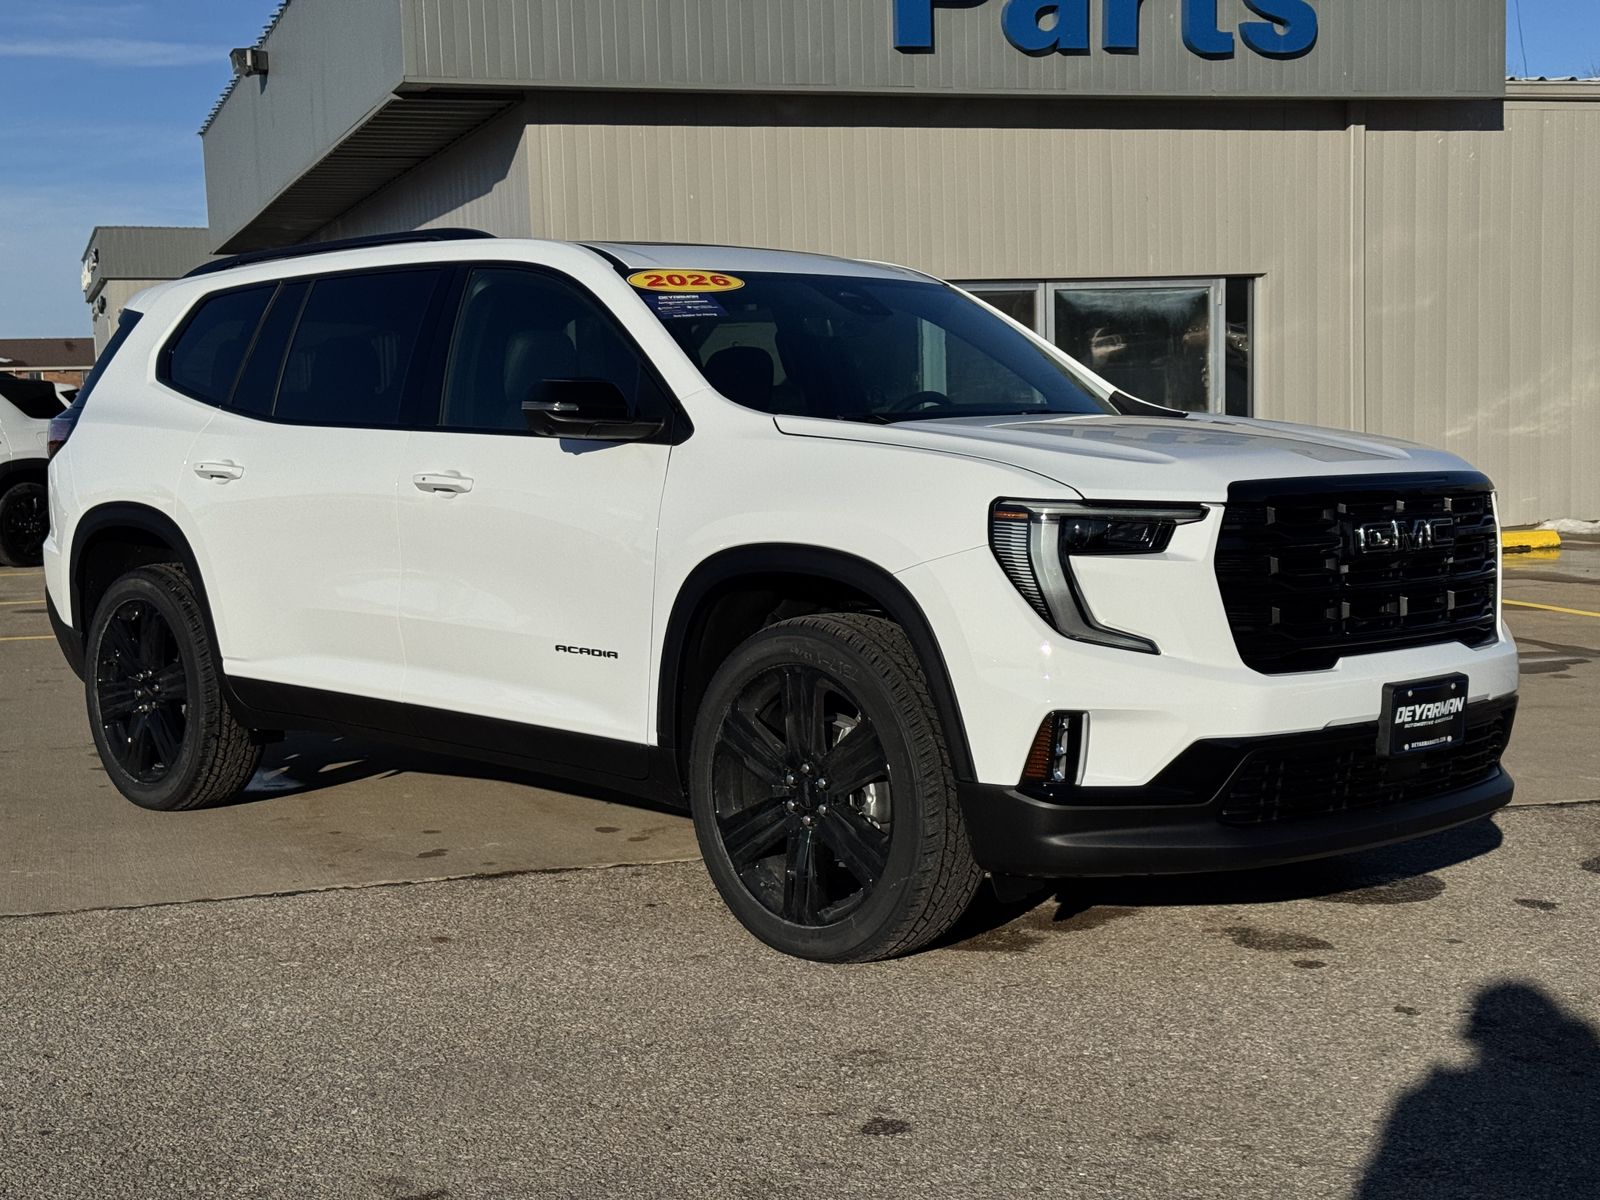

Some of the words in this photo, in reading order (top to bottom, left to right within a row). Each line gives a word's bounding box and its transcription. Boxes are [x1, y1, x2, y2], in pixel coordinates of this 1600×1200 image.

[643, 274, 732, 287] 2026
[1356, 518, 1454, 553] GMC
[555, 644, 618, 659] ACADIA
[1395, 696, 1465, 724] DEYARMAN
